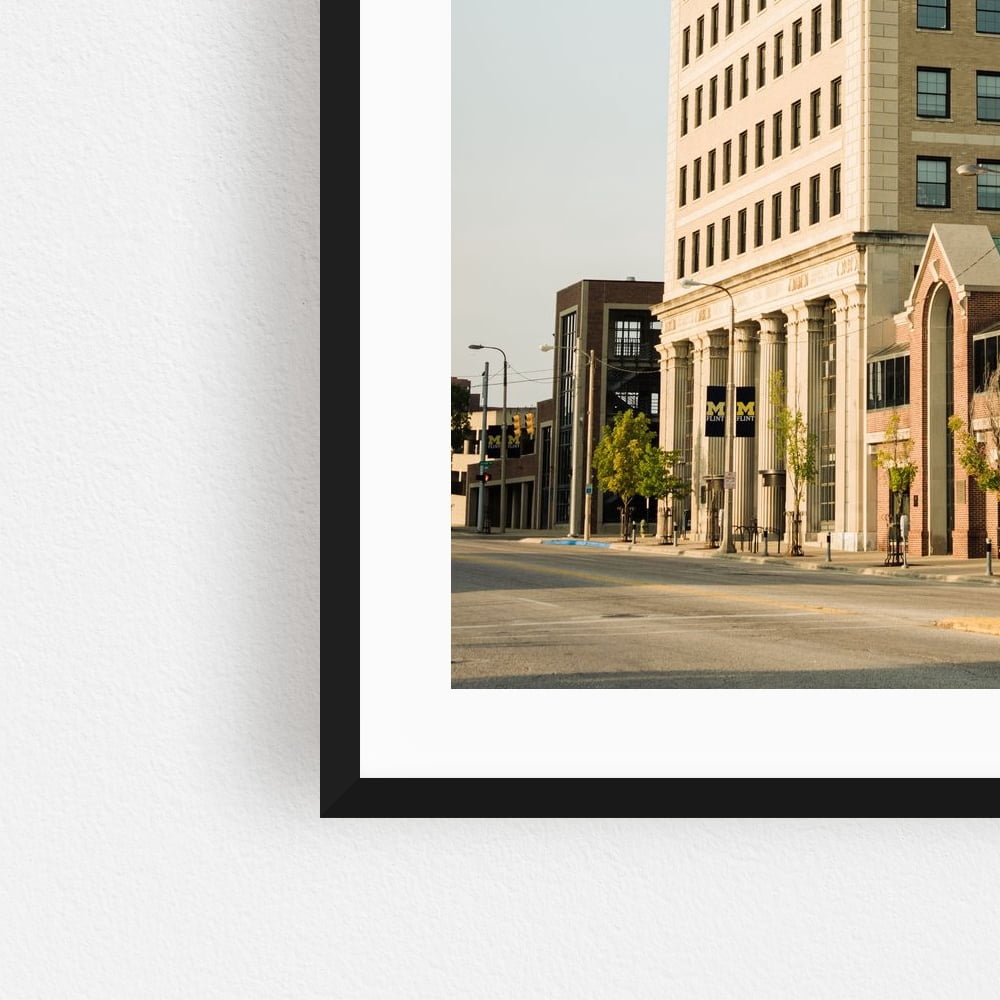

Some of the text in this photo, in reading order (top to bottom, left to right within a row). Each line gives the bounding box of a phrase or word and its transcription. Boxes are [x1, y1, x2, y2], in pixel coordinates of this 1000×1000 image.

[706, 401, 726, 416] M
[736, 401, 756, 416] M
[488, 435, 501, 445] M
